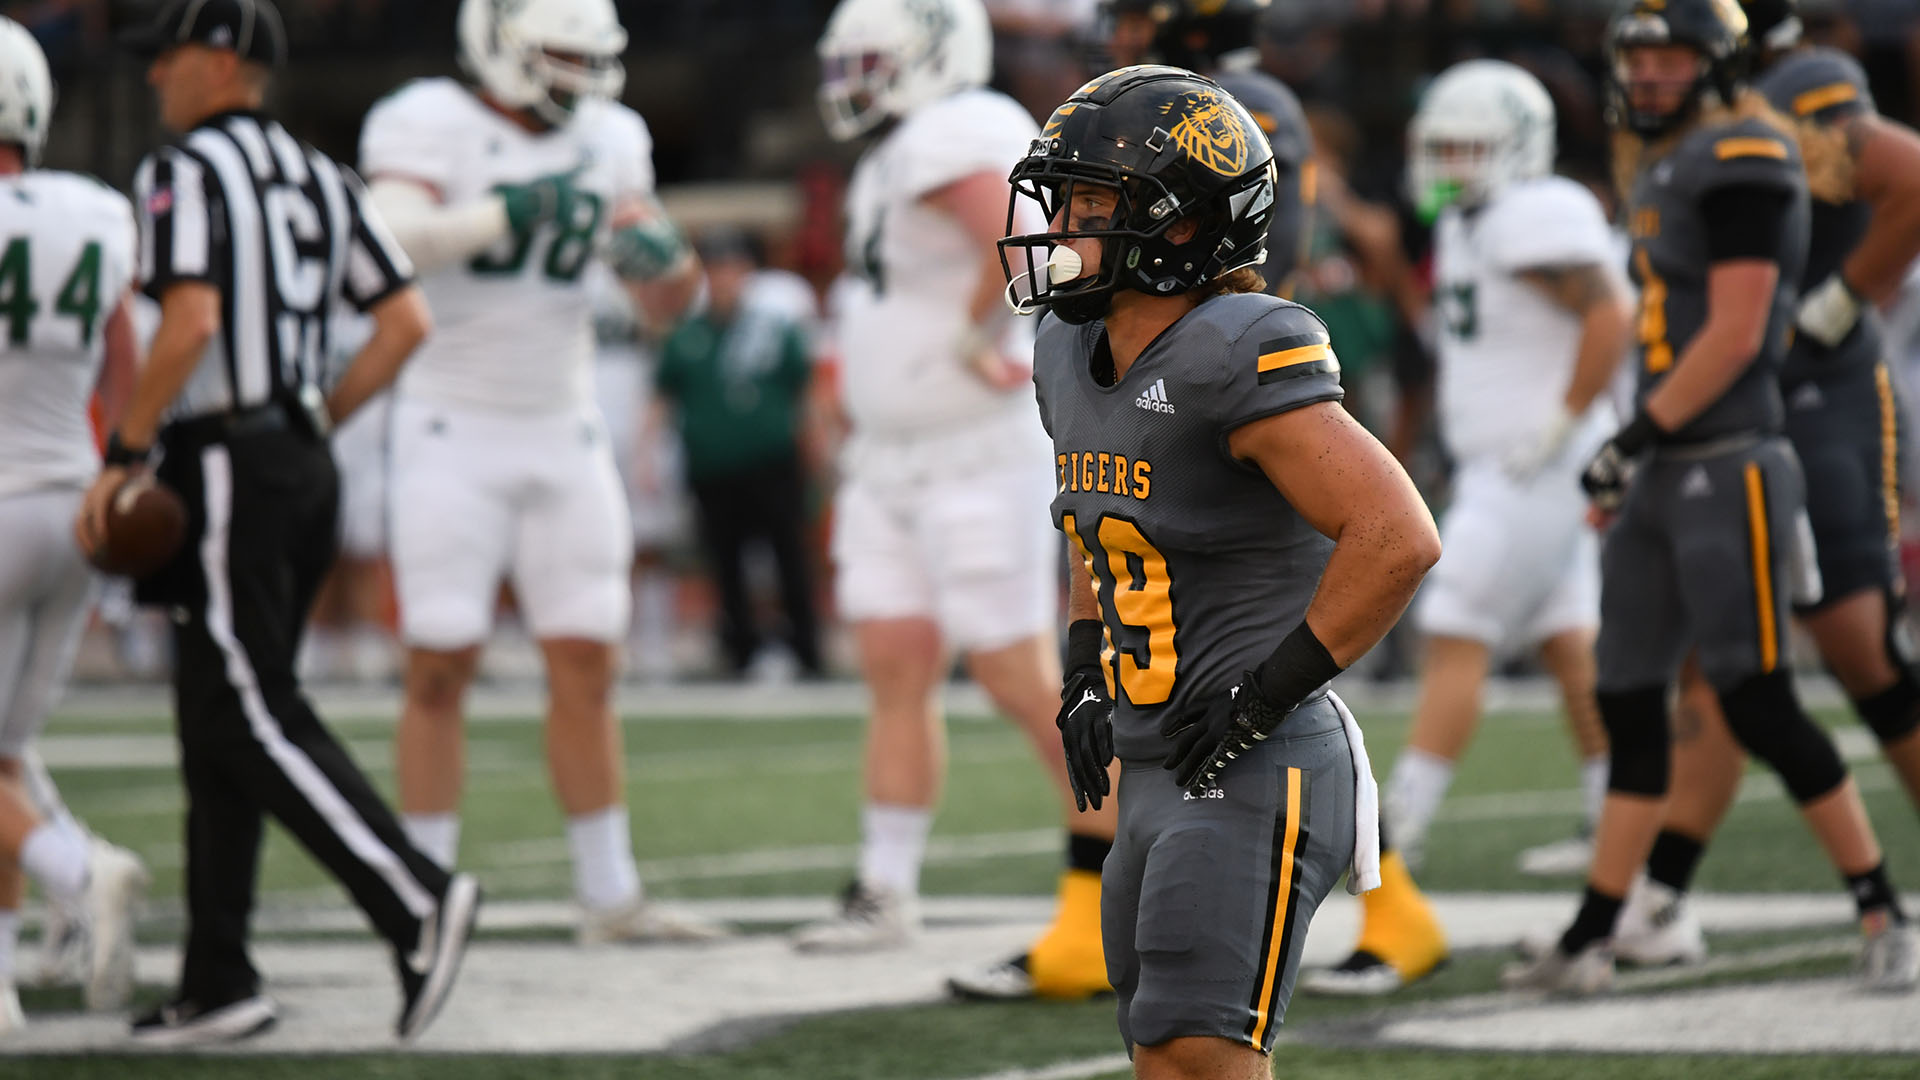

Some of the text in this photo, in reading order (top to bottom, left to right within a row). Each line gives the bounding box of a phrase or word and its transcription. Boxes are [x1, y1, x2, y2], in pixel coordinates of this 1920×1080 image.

[264, 186, 325, 311] C
[0, 236, 102, 348] 44
[1135, 397, 1175, 414] adidas
[1057, 451, 1152, 500] TIGERS
[1062, 510, 1178, 709] 19
[1183, 786, 1225, 800] adas
